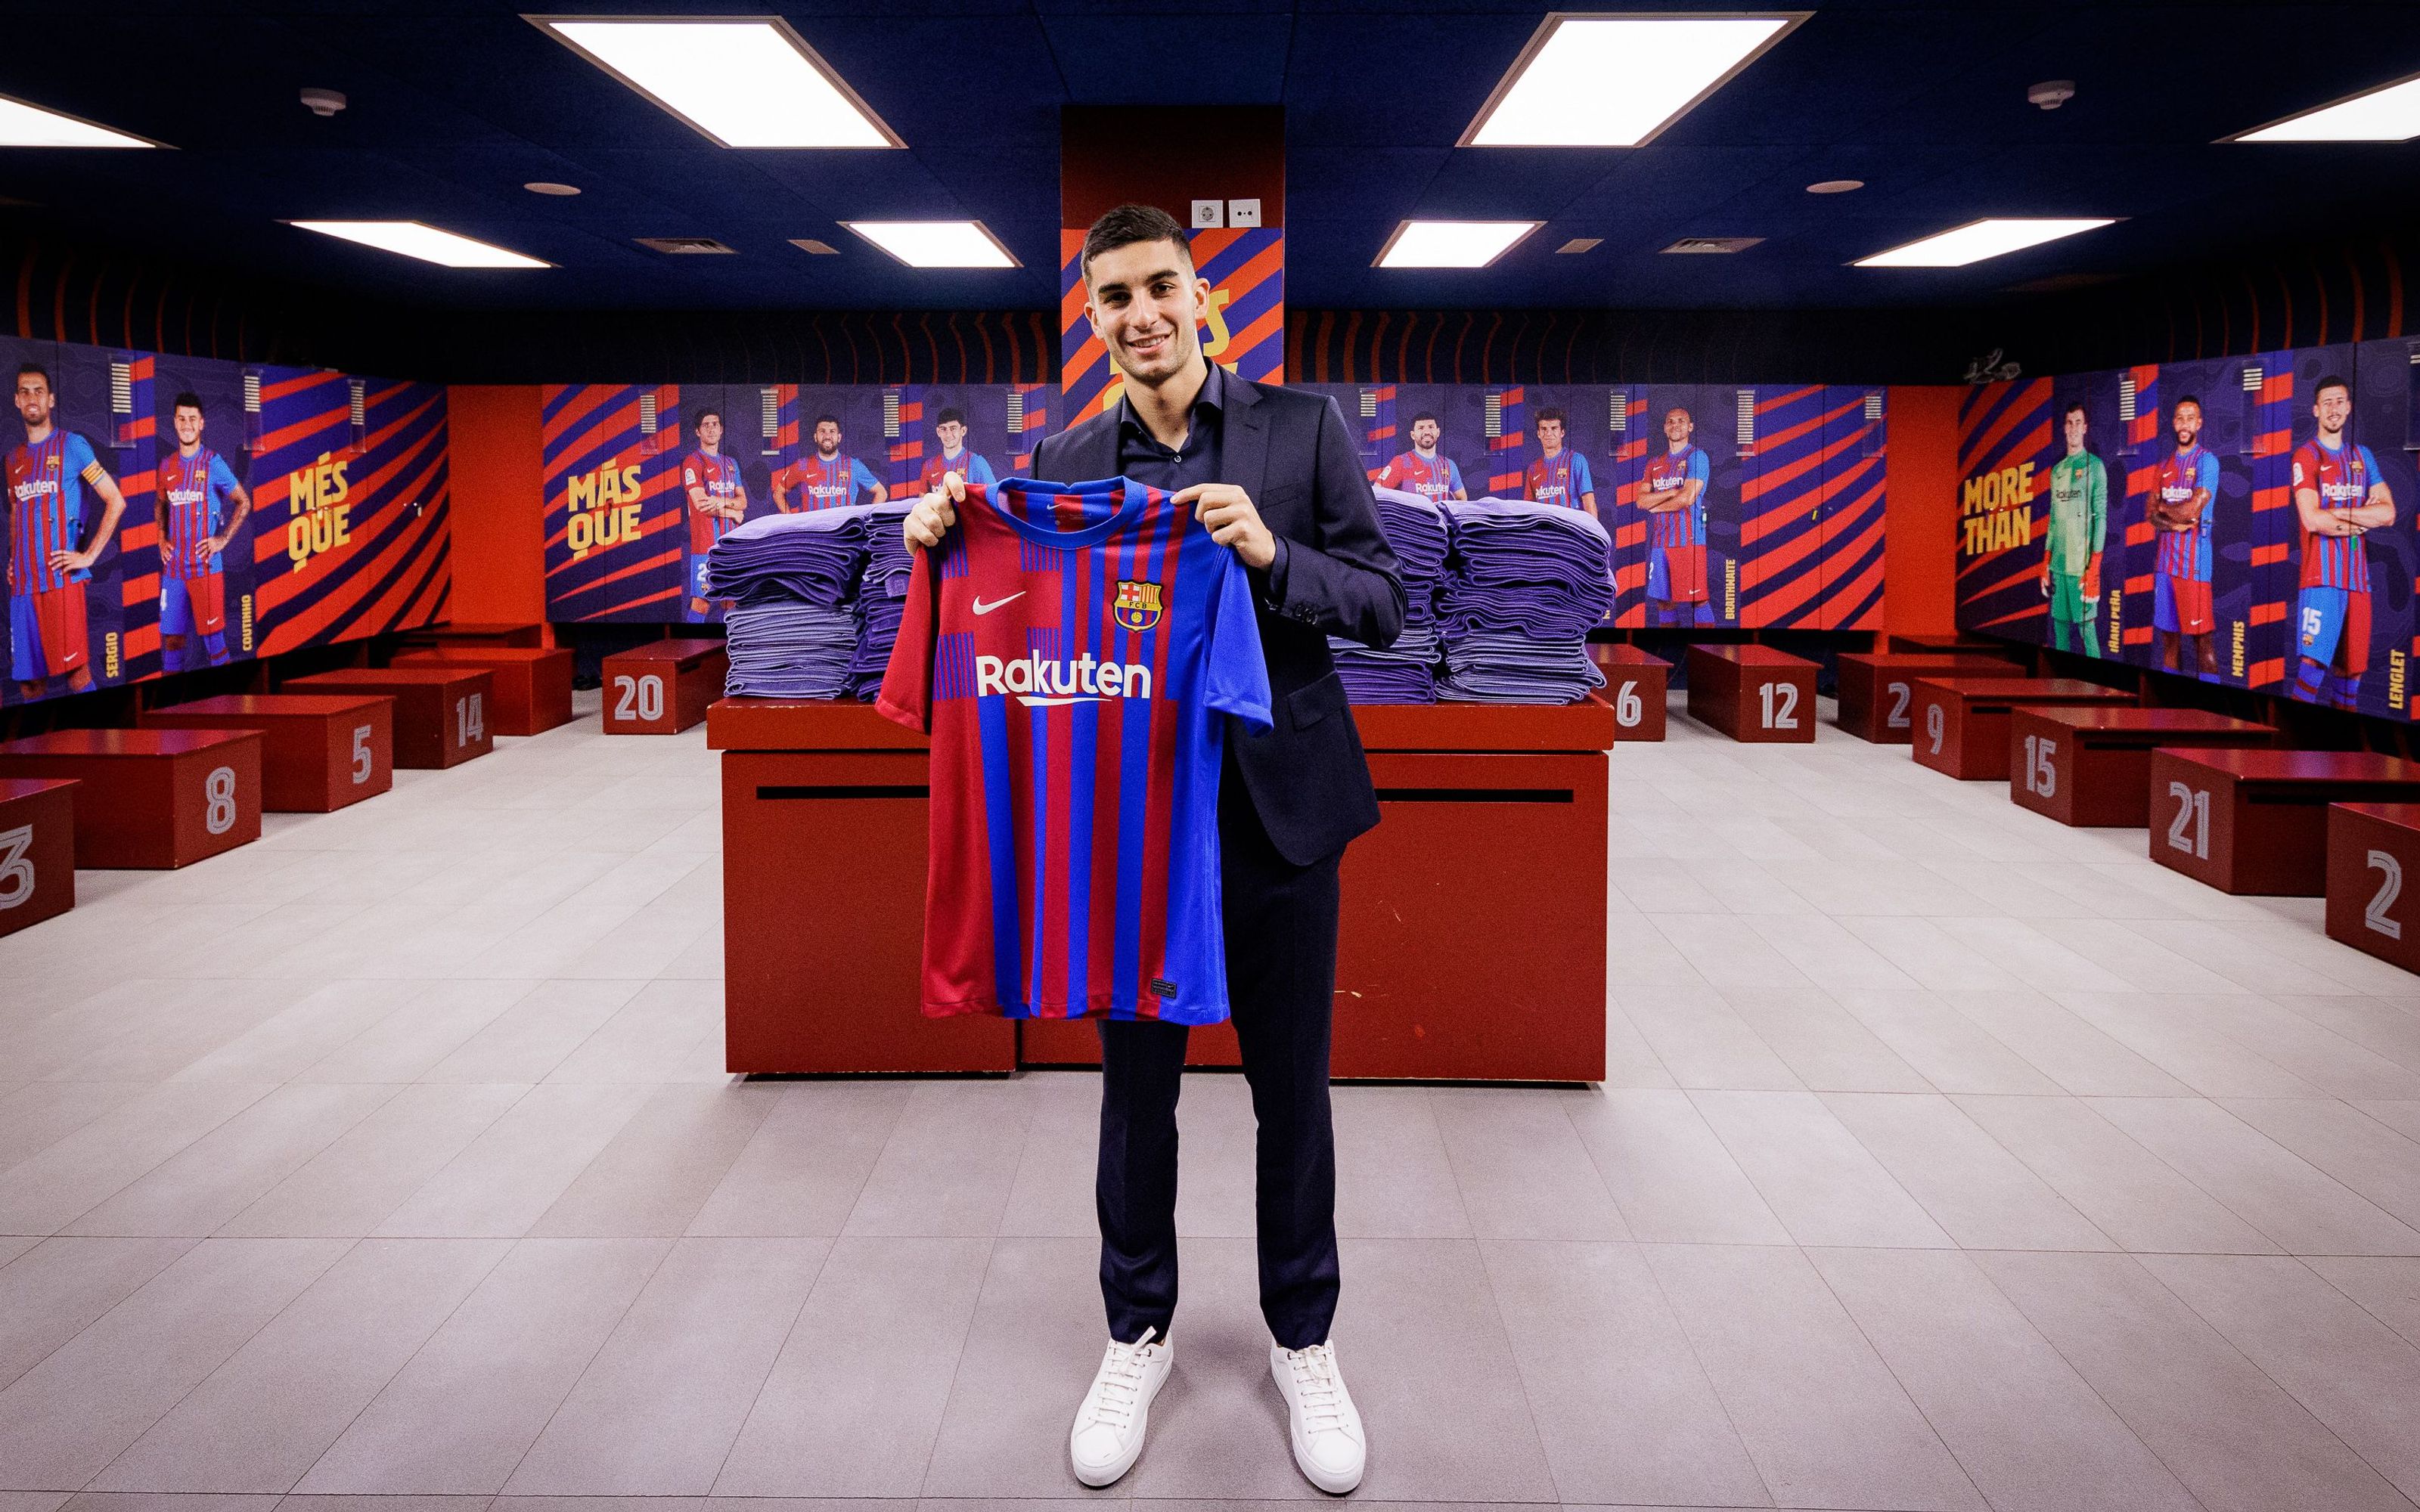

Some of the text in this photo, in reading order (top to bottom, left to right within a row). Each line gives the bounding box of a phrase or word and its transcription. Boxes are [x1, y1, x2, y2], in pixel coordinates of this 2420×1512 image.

[290, 451, 349, 515] MÉS
[568, 457, 641, 513] MÁS
[808, 485, 847, 496] Rakuten
[1536, 485, 1565, 497] akuten
[1964, 461, 2035, 515] MORE
[2322, 482, 2363, 497] Rakuten
[288, 503, 350, 574] QUE
[568, 503, 642, 562] QUE
[1964, 506, 2031, 556] THAN
[1725, 559, 1736, 619] BRAITHWAITE
[2108, 590, 2121, 619] PEÑA
[240, 594, 253, 652] COUTINHO
[2302, 606, 2322, 635] 15
[105, 632, 119, 678] SERGIO
[976, 649, 1152, 699] Rakuten
[2232, 621, 2245, 677] MEMPHIS
[614, 674, 663, 720] 20
[1616, 681, 1642, 727] 6
[1759, 683, 1798, 729] 12
[2388, 649, 2405, 709] LENGLET
[457, 693, 484, 748] 14
[1927, 704, 1944, 754] 9
[352, 724, 371, 784] 5
[2025, 735, 2057, 798] 15
[206, 767, 236, 835] 8
[2168, 781, 2210, 860] 21
[0, 823, 35, 910] 3
[2365, 849, 2402, 940] 2
